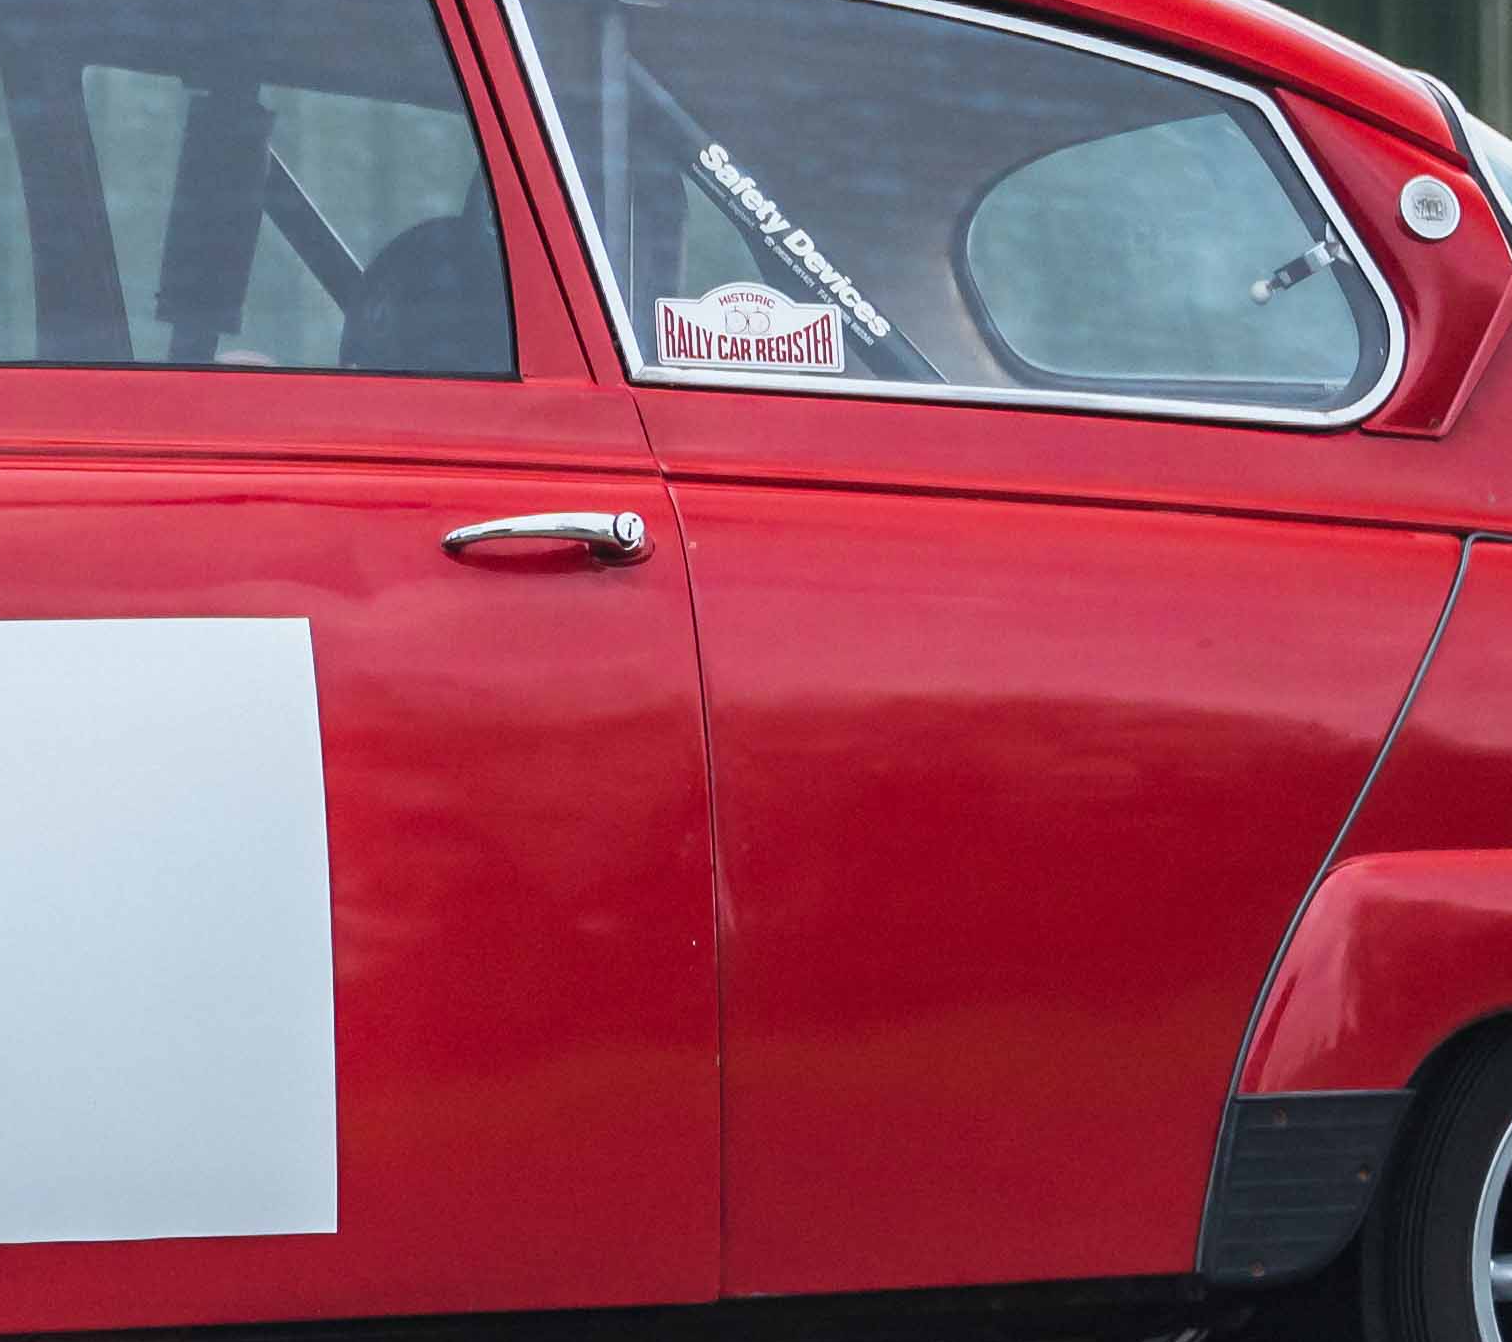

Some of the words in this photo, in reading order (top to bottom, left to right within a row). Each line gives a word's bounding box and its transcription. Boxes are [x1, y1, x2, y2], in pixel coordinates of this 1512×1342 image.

[699, 144, 790, 234] Safety
[783, 228, 891, 337] Devices
[718, 292, 776, 309] HISTORIC
[664, 305, 713, 360] RALLY
[718, 334, 752, 362] CAR
[755, 313, 834, 365] REGISTER
